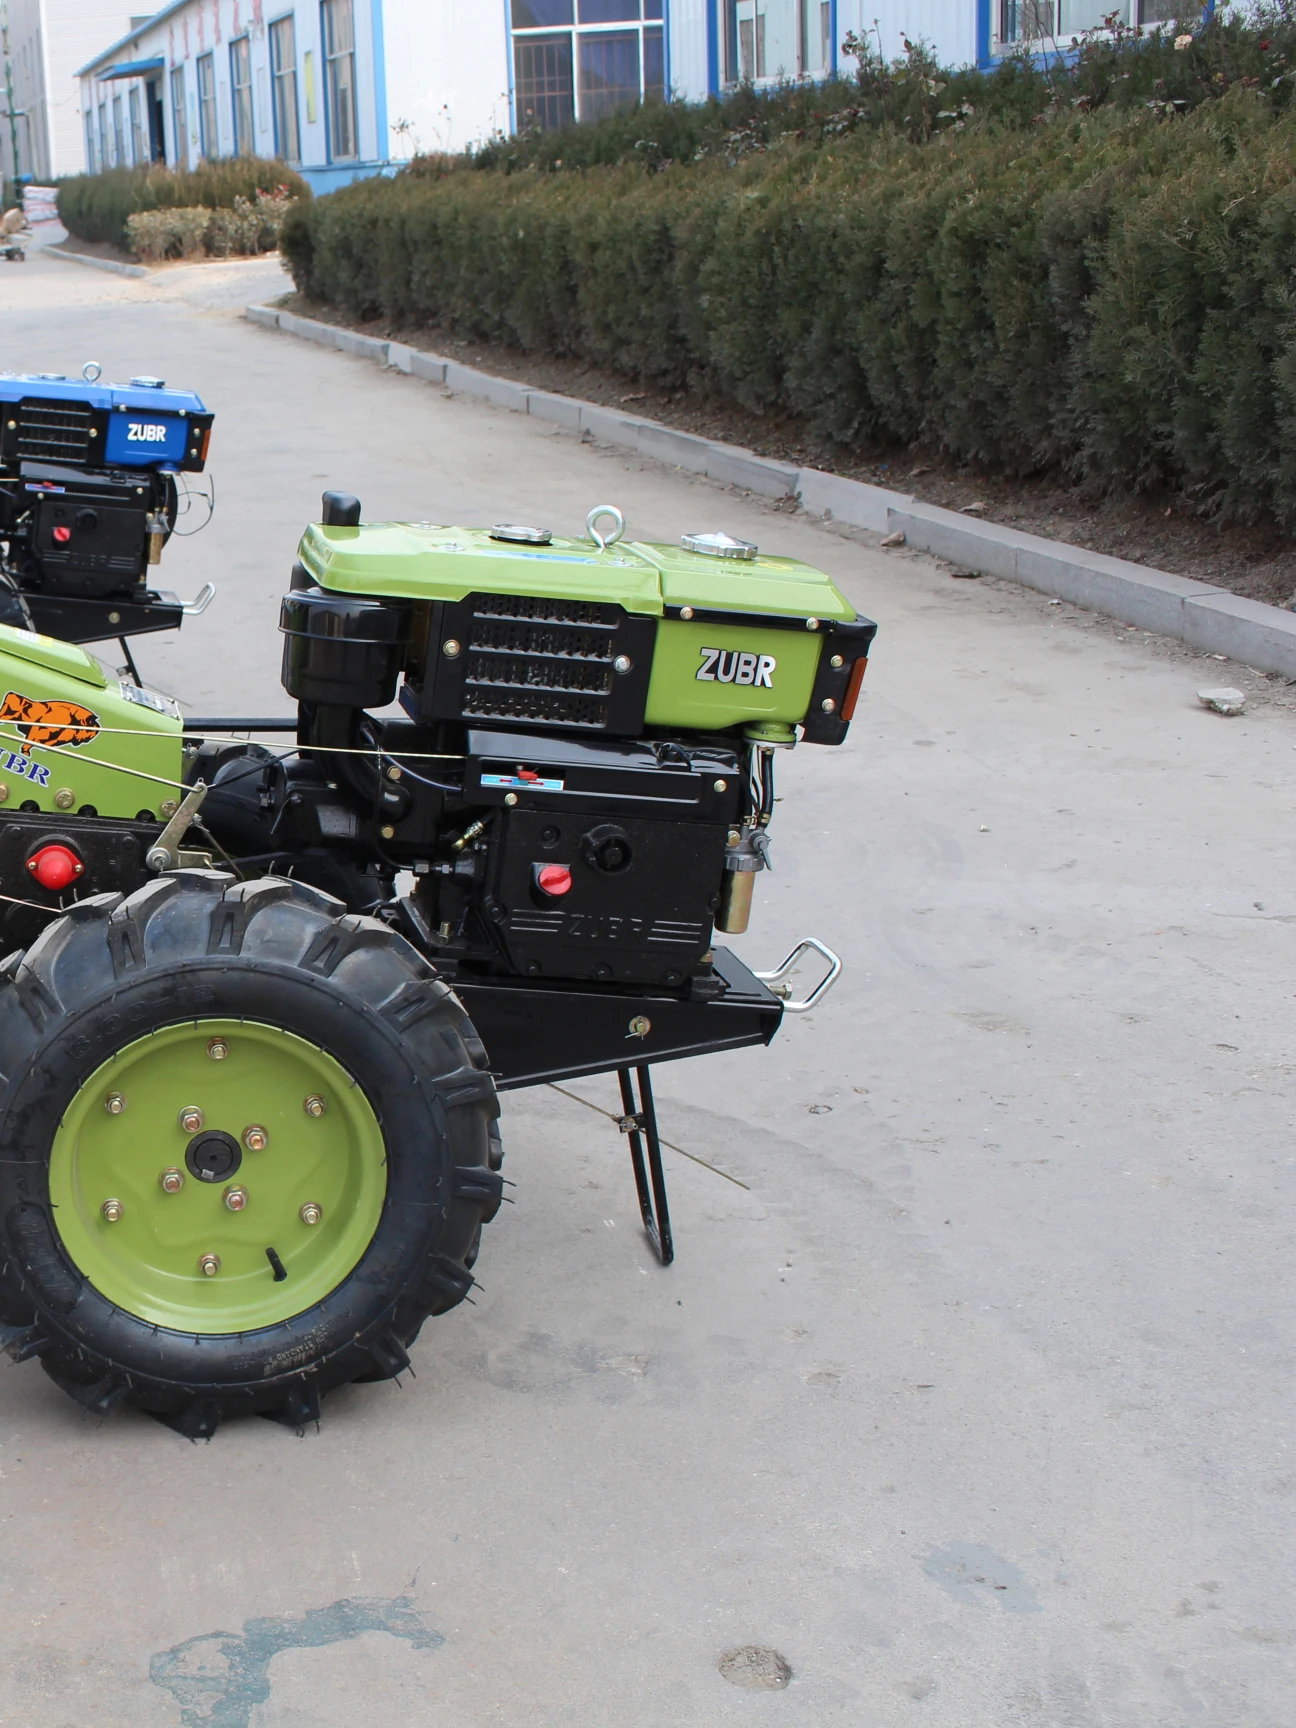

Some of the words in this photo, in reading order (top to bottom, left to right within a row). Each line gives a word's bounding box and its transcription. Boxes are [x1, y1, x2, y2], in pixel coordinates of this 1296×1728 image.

[127, 422, 167, 442] ZUBR
[695, 647, 776, 689] ZUBR
[567, 914, 643, 942] ZUBR
[276, 1341, 314, 1360] STANDARD
